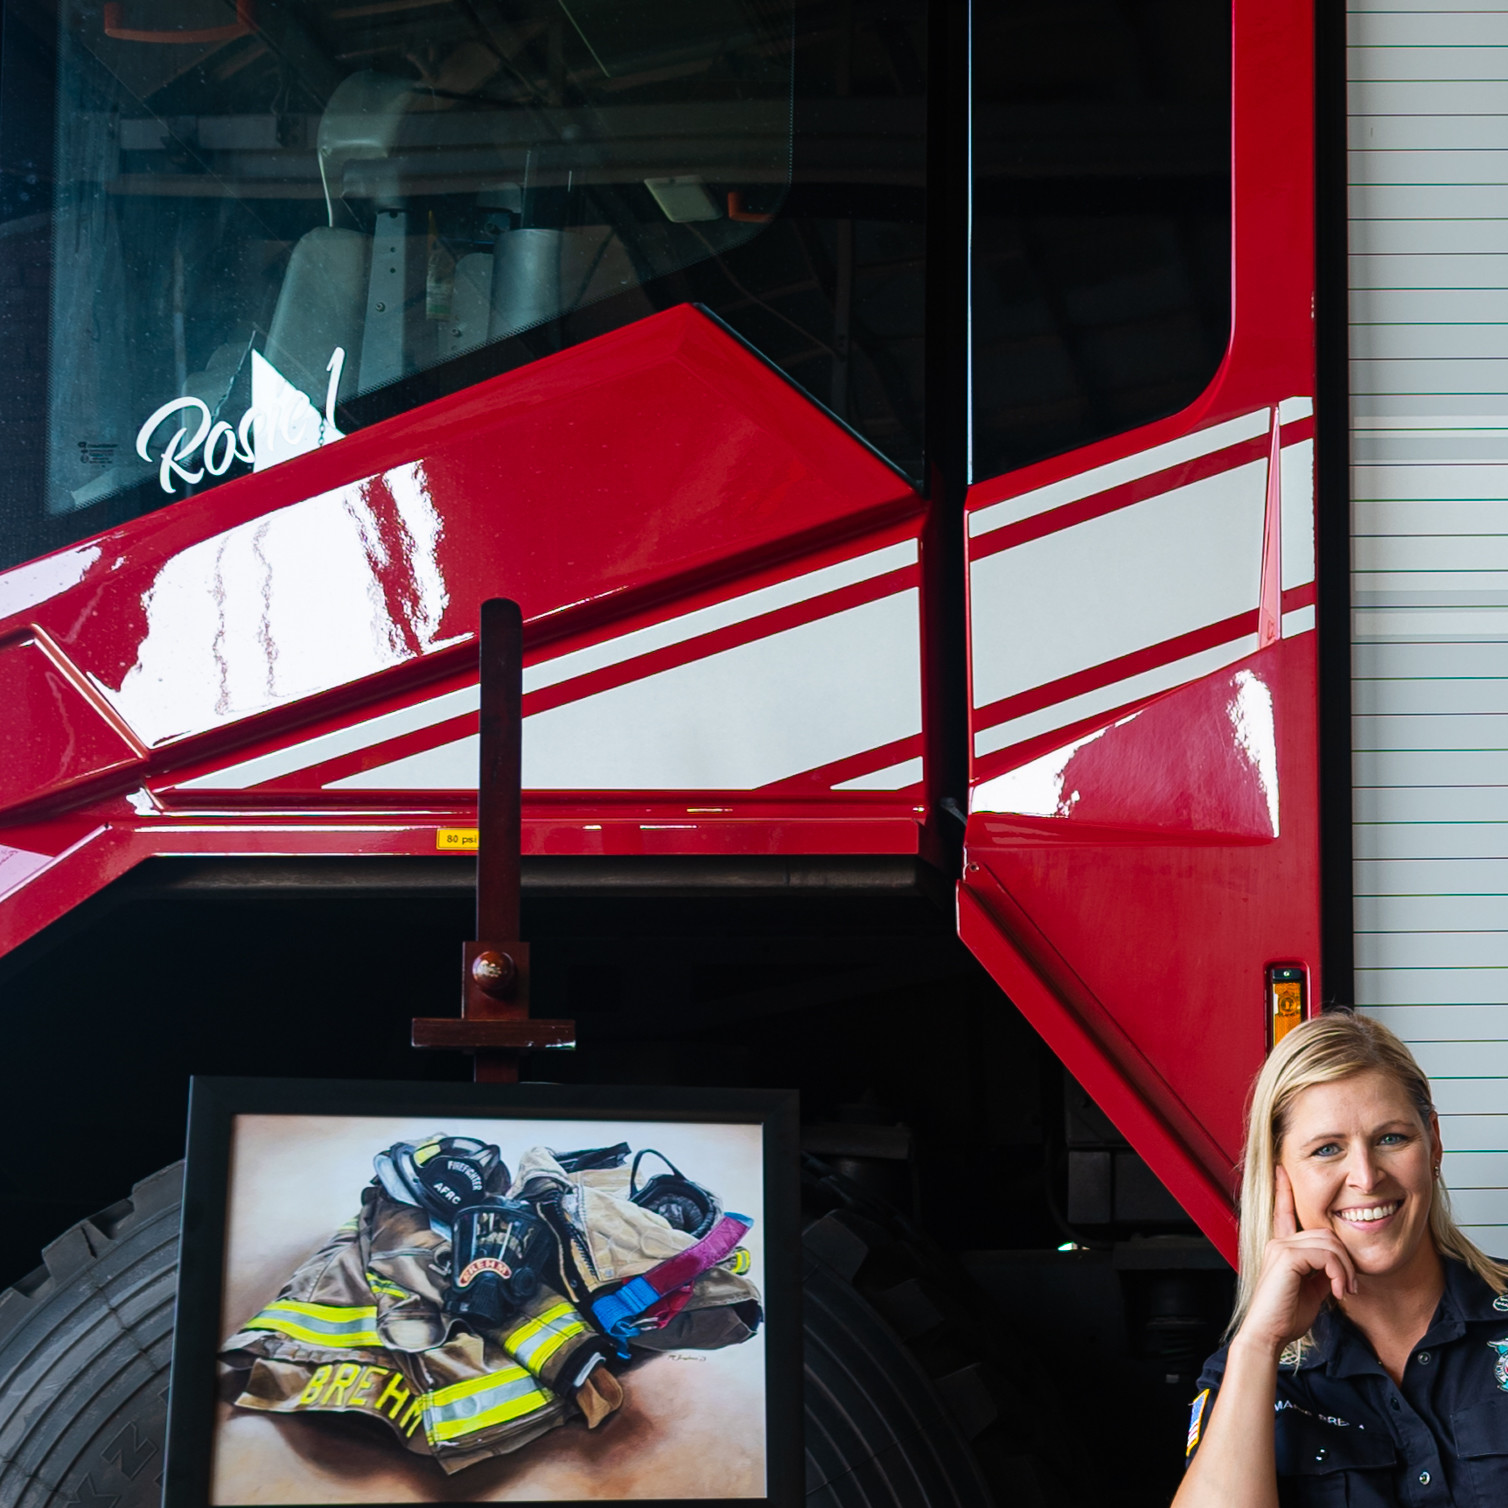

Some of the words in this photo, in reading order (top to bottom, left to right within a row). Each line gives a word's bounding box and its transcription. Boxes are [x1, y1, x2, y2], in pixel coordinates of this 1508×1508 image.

[446, 834, 458, 843] 80
[447, 1160, 483, 1191] FIREFIGHTER
[433, 1182, 461, 1204] AFRC
[300, 1362, 423, 1438] BREHM
